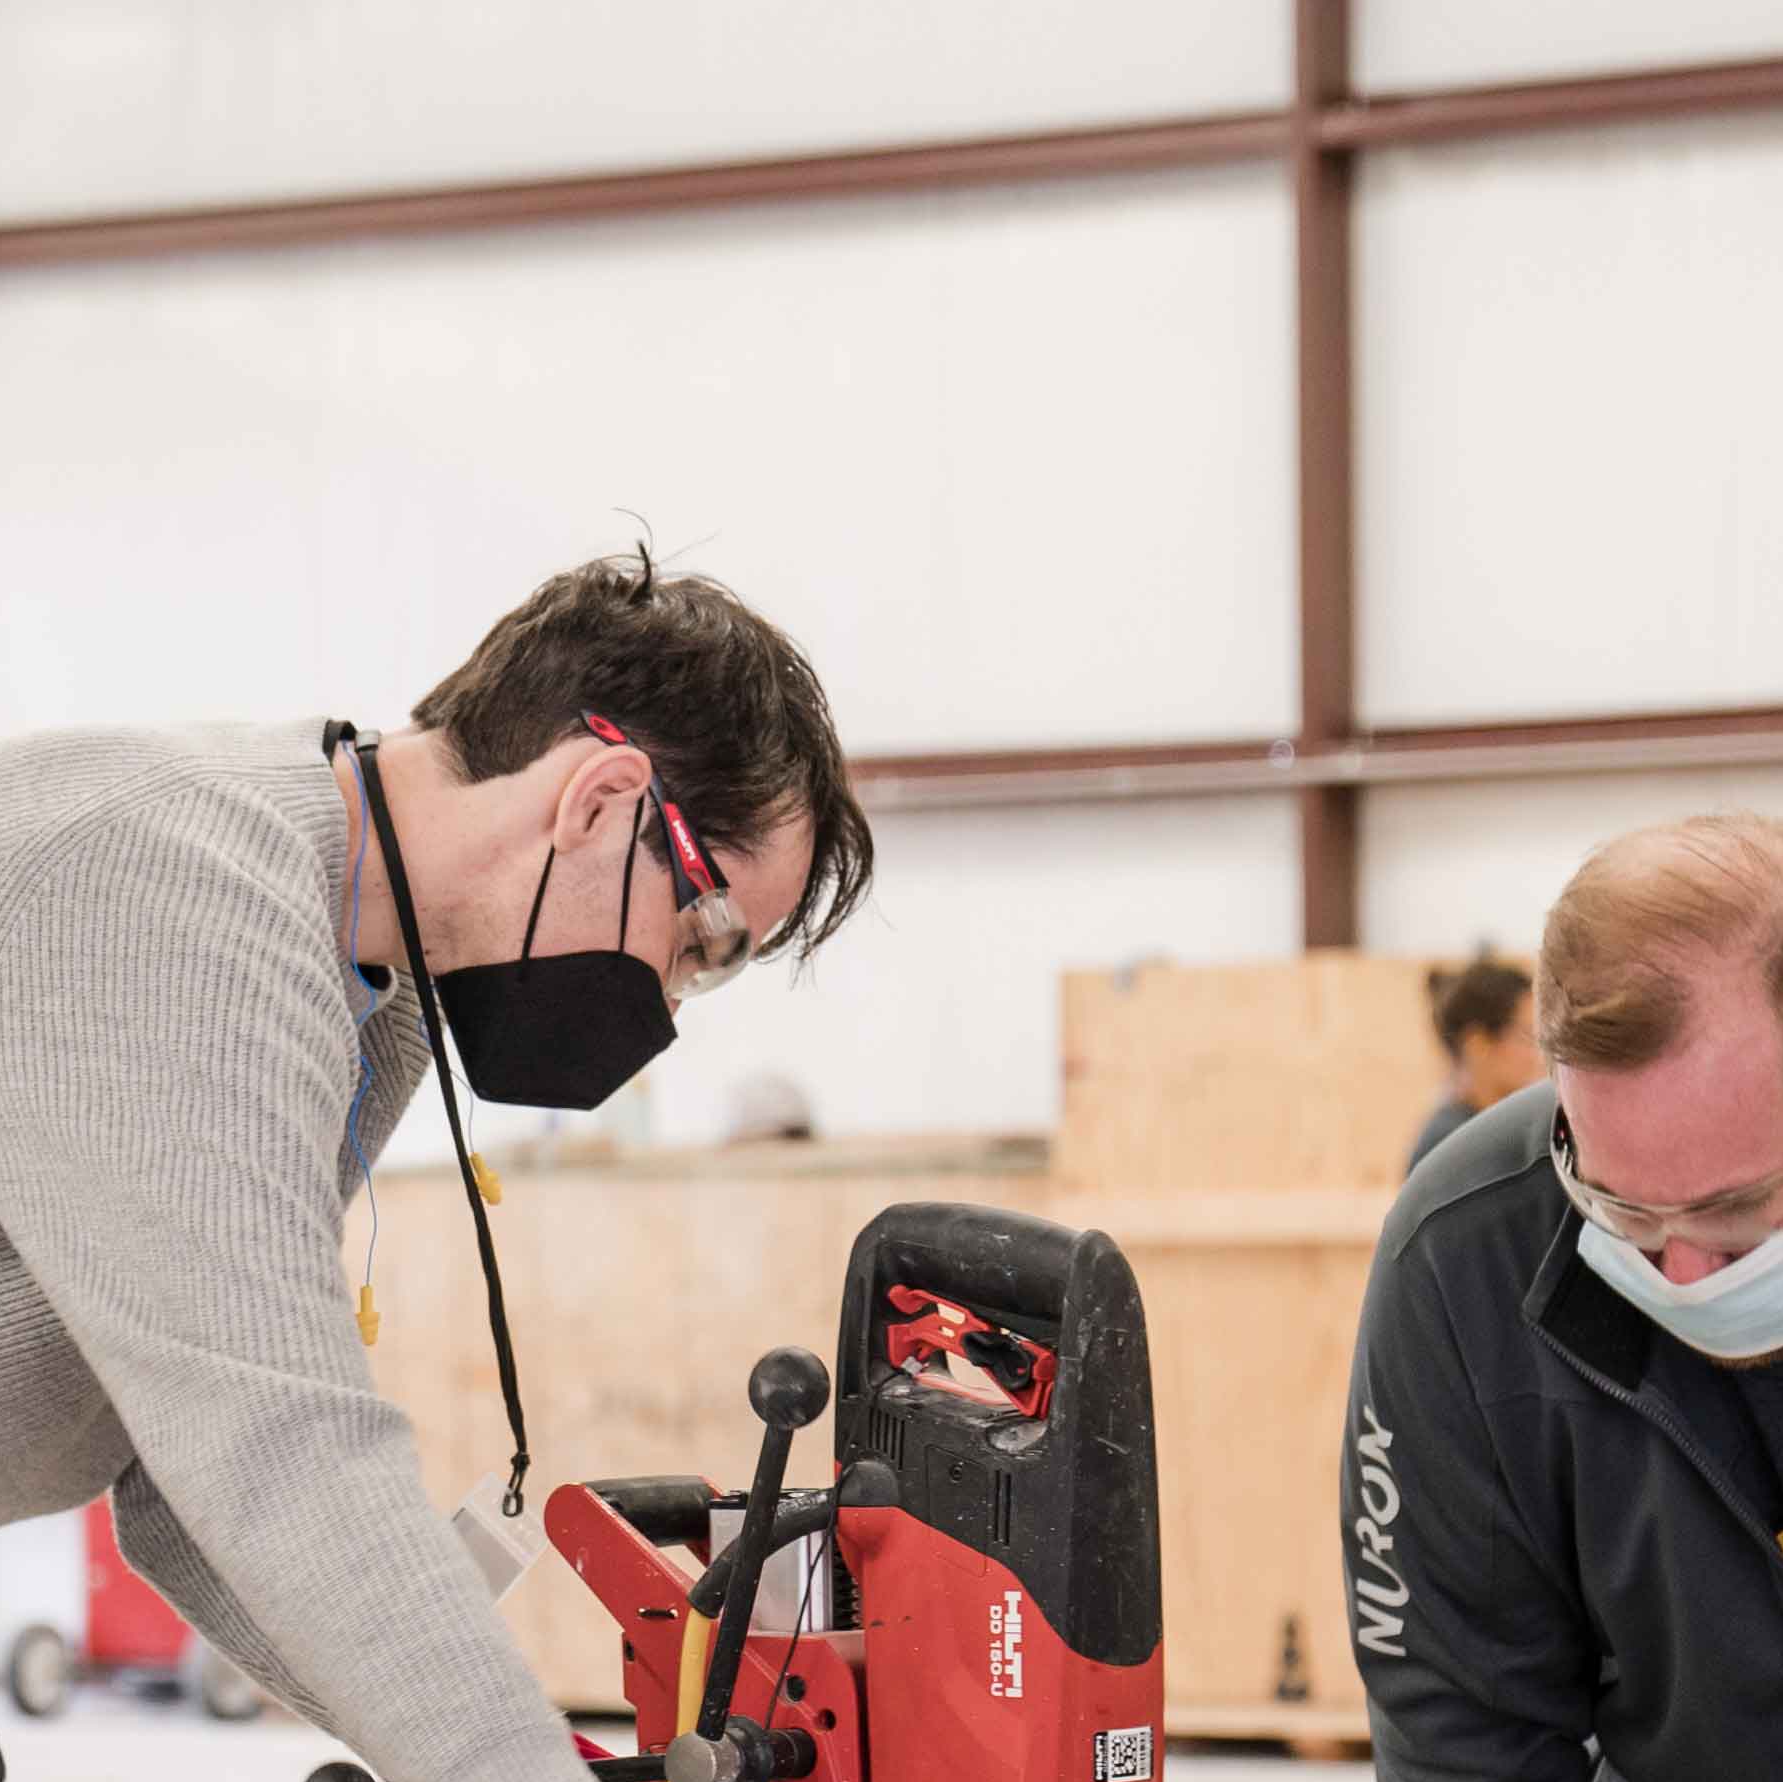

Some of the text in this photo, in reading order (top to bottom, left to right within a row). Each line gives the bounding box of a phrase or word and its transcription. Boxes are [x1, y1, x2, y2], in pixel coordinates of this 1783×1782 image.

[1355, 1404, 1410, 1657] NURON
[989, 1605, 1003, 1635] DD
[1004, 1590, 1023, 1698] HILTI
